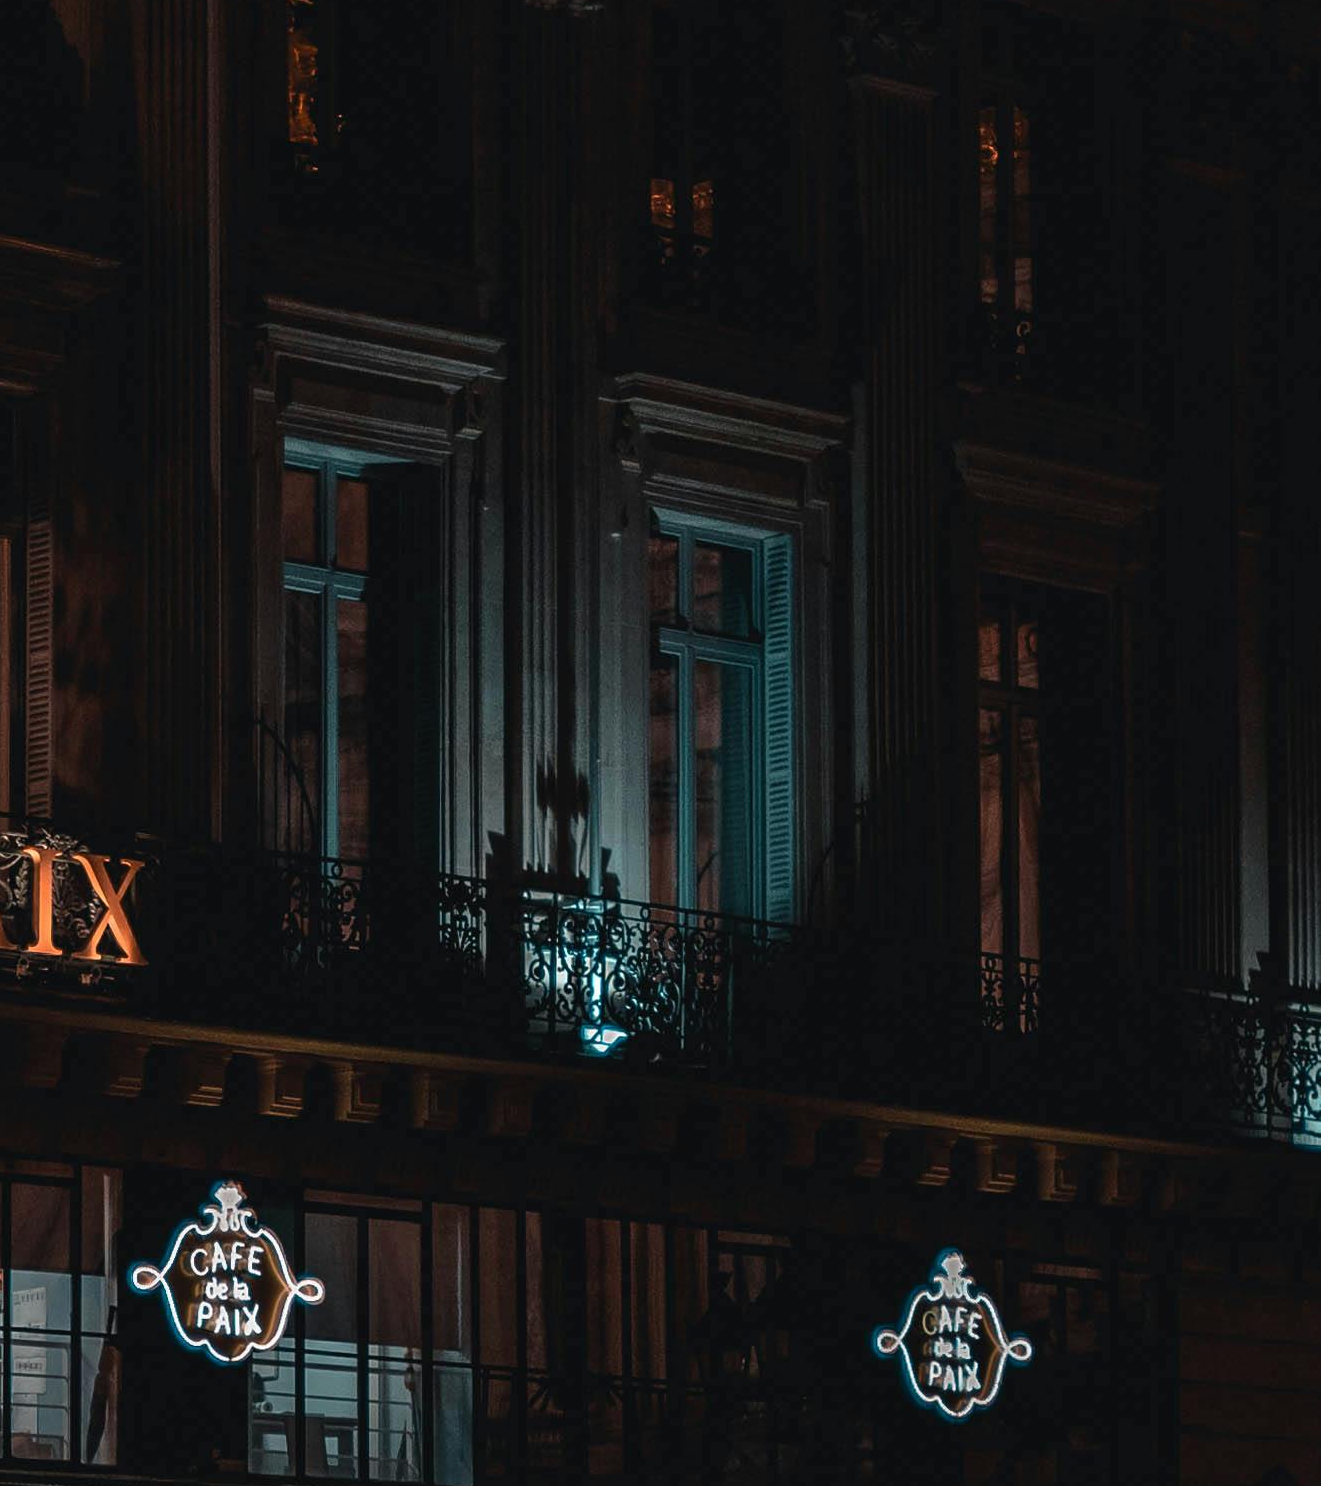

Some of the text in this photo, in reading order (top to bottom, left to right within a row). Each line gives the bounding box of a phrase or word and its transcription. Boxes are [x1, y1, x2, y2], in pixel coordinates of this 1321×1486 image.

[190, 1241, 264, 1277] CAFE
[205, 1276, 251, 1301] de la
[196, 1302, 262, 1336] PAIX
[928, 1361, 982, 1392] PAIX
